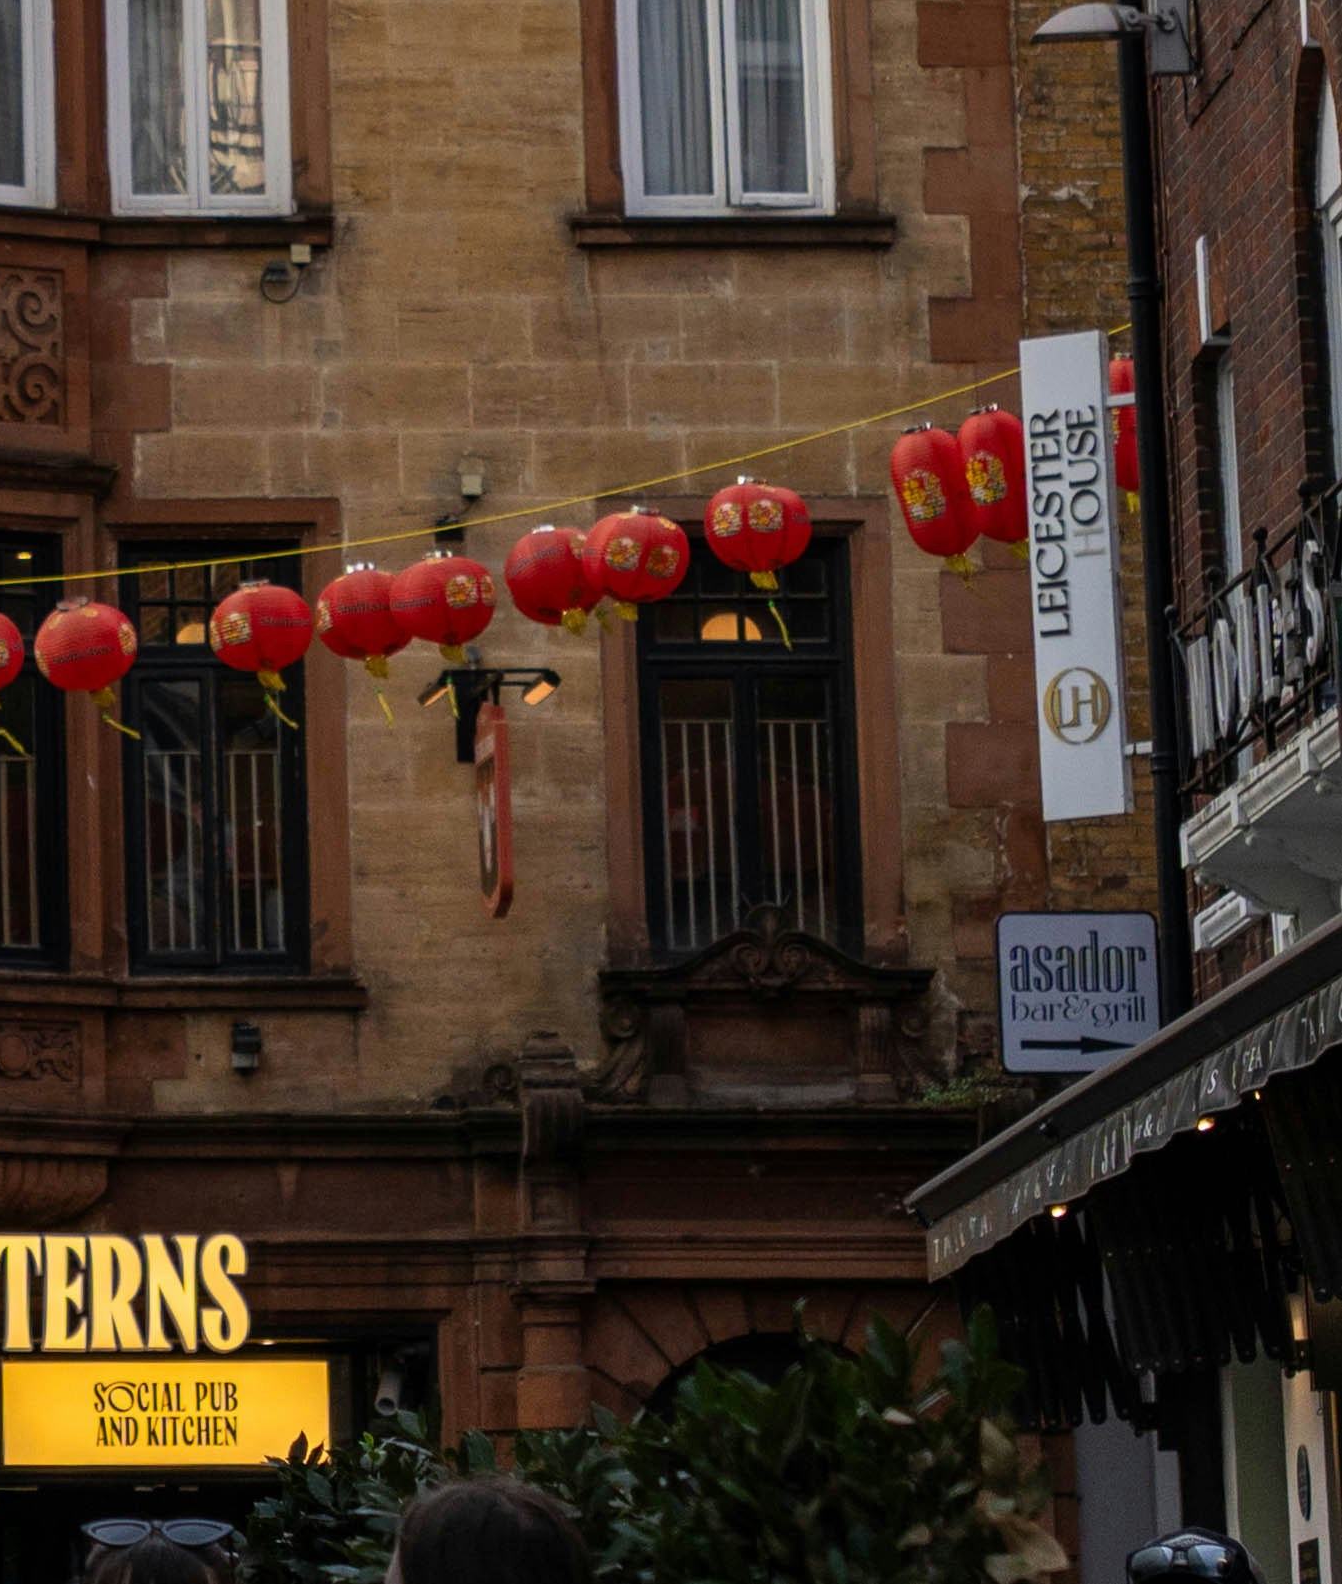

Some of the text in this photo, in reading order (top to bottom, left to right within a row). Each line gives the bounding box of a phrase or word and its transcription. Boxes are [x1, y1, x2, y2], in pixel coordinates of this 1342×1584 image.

[1064, 404, 1107, 559] HOUSE
[1030, 407, 1072, 638] LEICESTER
[1009, 929, 1147, 993] asador
[93, 1380, 239, 1413] SOCIAL PUB
[96, 1415, 239, 1447] AND KITCHEN
